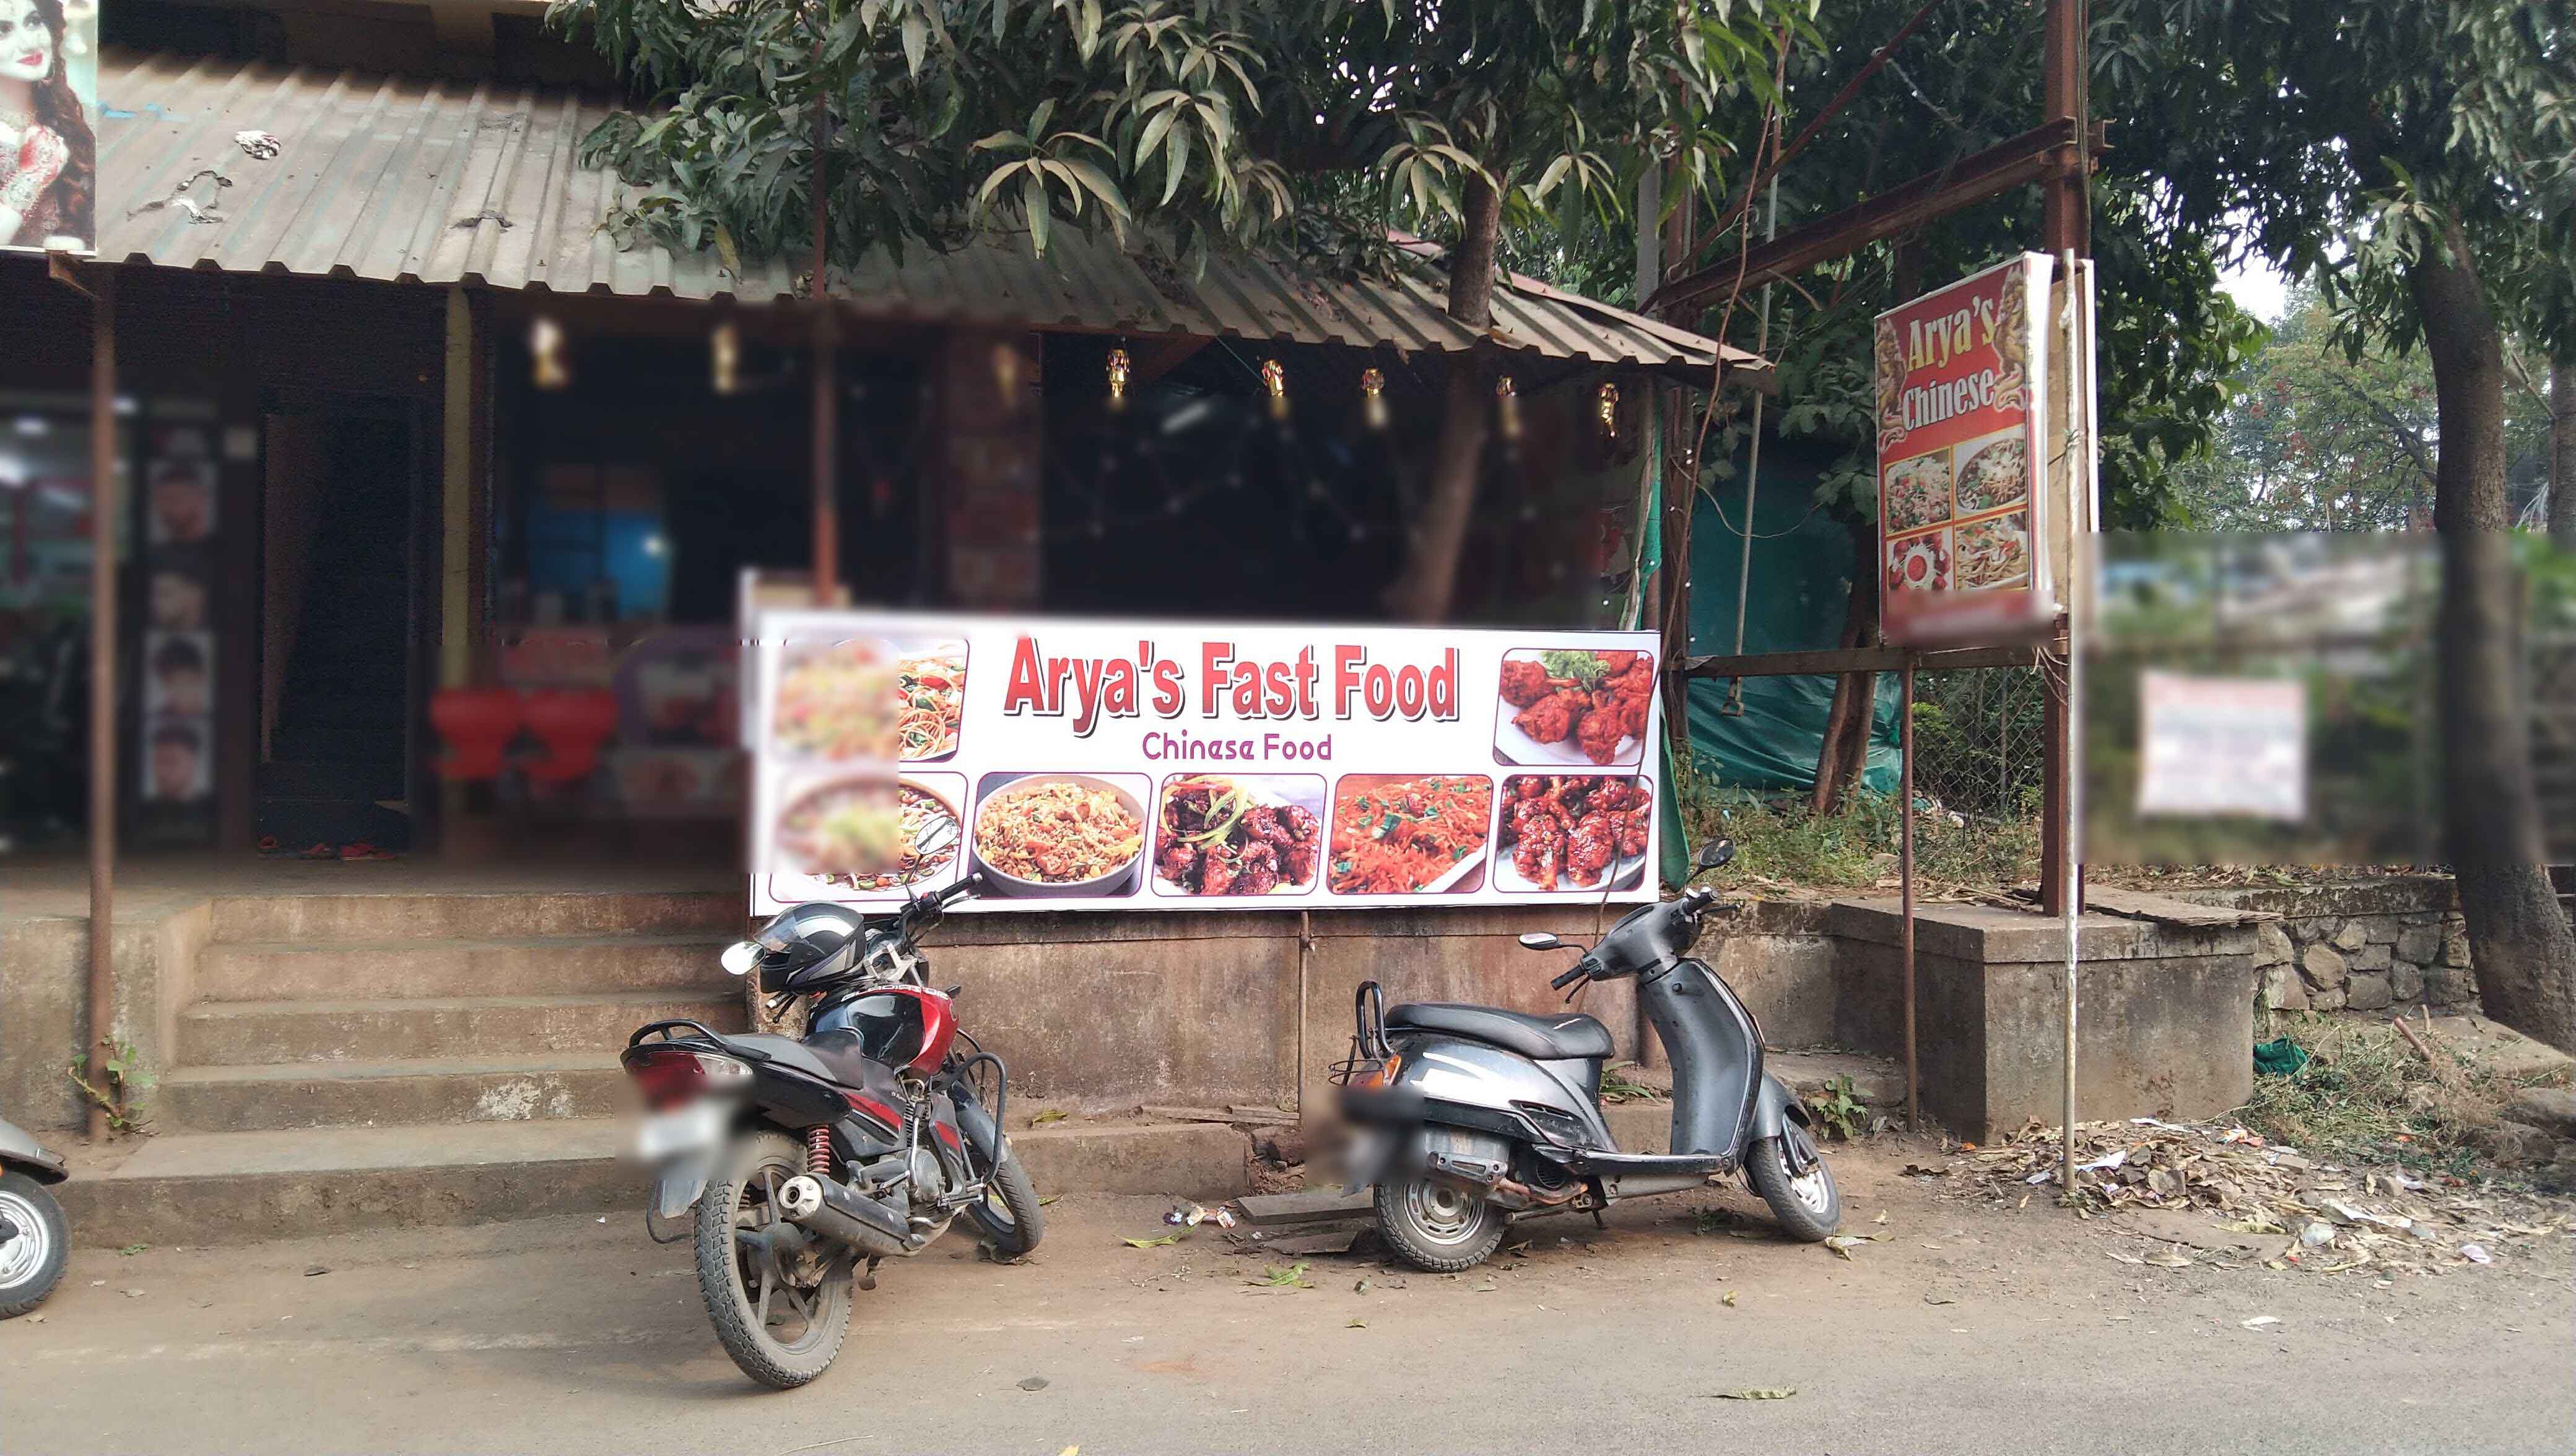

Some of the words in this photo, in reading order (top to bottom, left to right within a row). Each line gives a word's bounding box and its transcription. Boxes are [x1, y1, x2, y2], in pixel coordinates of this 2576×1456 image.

[1907, 294, 1995, 371] Arya's
[1902, 368, 1995, 431] Chinese
[1004, 635, 1185, 738] Arya's
[1201, 641, 1320, 721] Fast
[1334, 644, 1460, 722] Food
[1142, 729, 1255, 760] Chinese
[1264, 733, 1331, 760] Food
